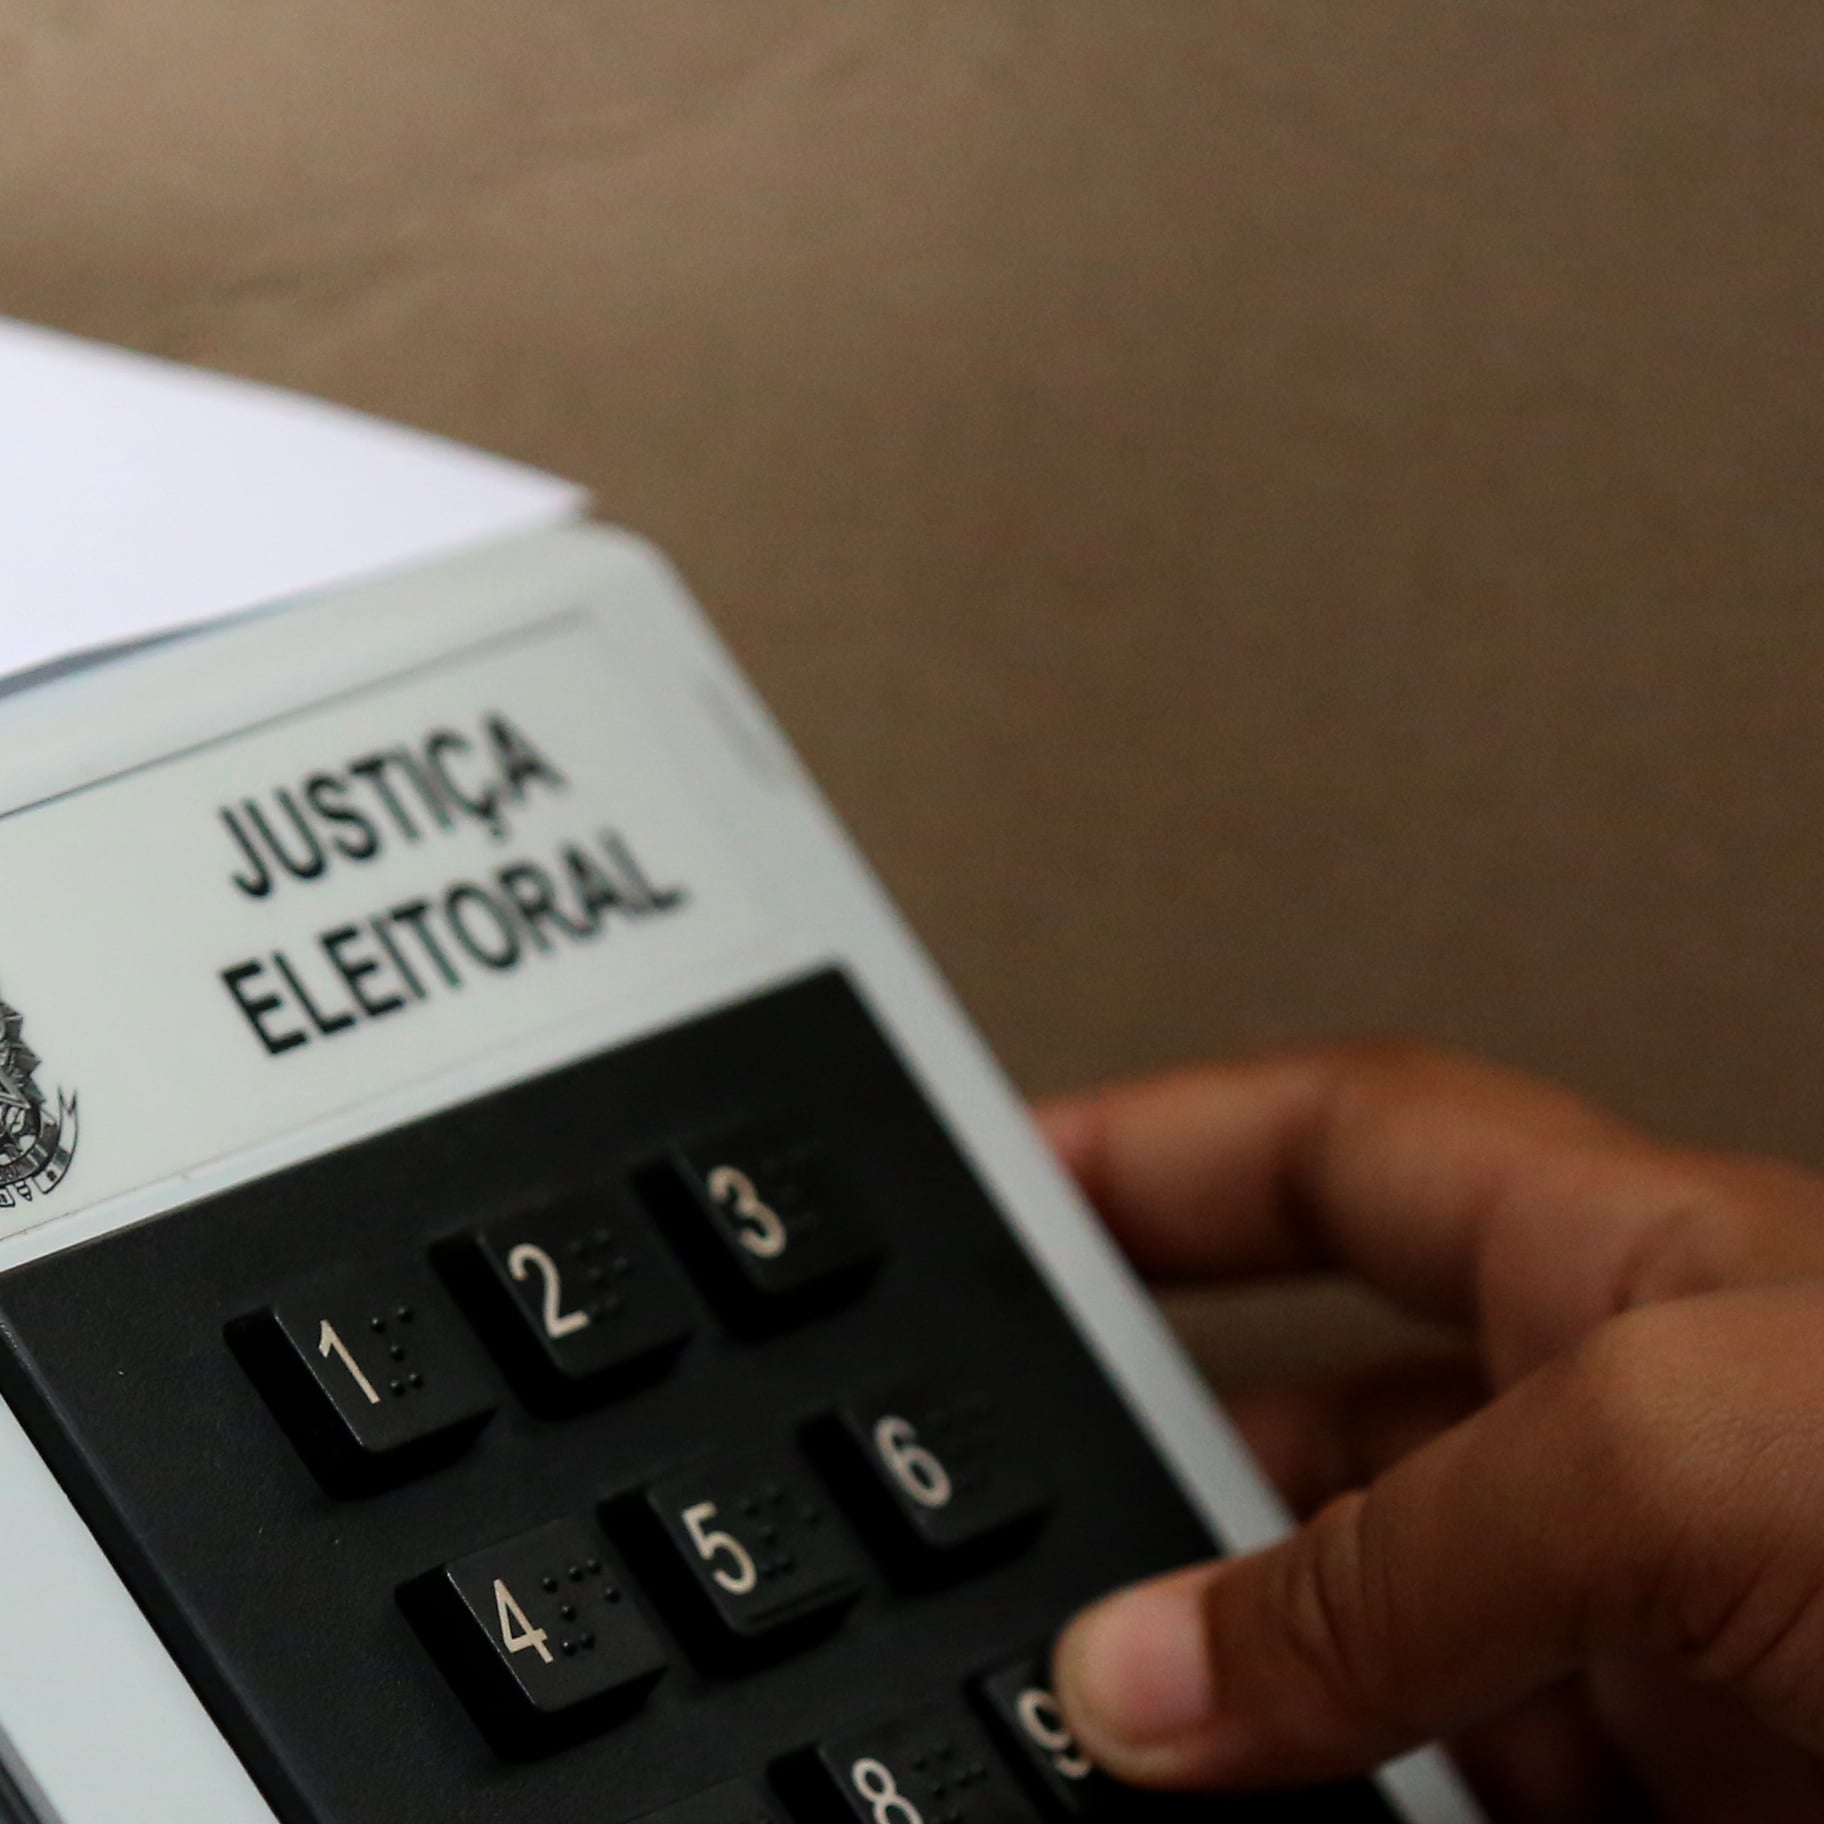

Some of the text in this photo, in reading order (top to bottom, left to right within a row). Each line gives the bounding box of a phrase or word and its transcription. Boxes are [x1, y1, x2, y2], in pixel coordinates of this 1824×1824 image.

[219, 711, 566, 899] JUSTIÇA
[220, 828, 688, 1056] ELEITORAL
[319, 1166, 787, 1404] 1 2 3
[494, 1416, 952, 1664] 4 5 6
